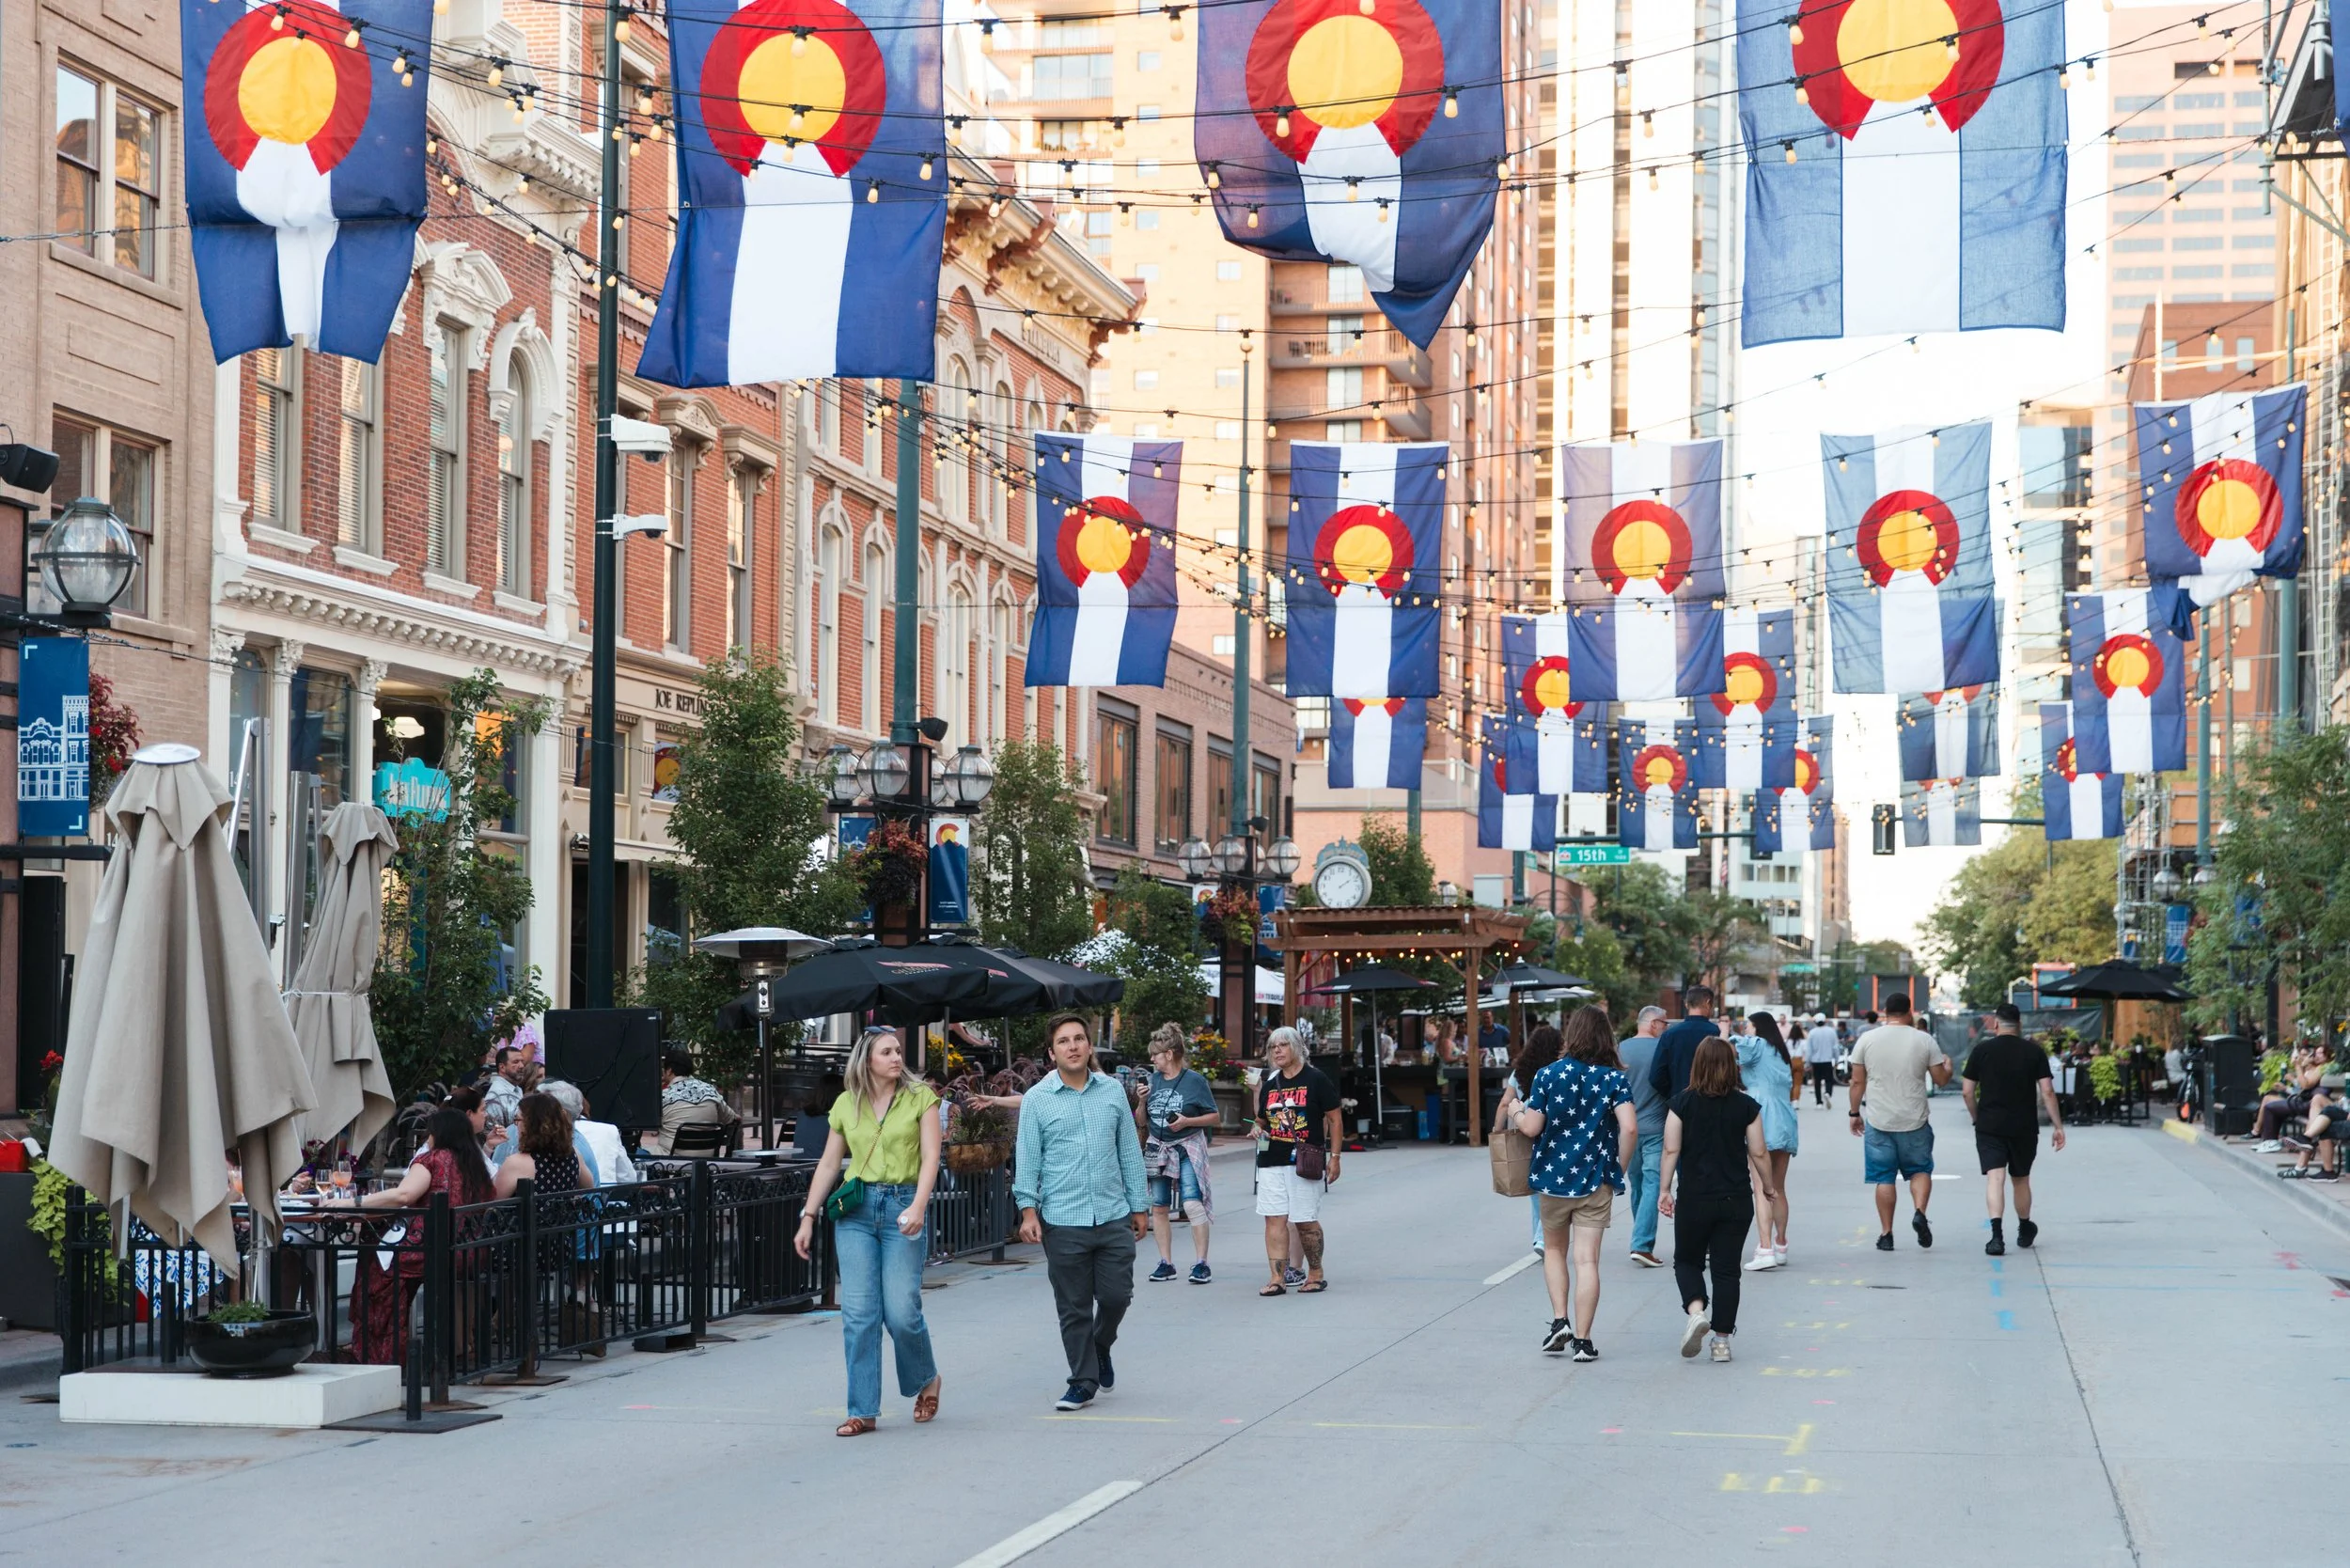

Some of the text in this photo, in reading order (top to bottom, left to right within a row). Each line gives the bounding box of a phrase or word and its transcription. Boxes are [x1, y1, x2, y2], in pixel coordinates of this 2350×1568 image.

[655, 688, 672, 709] JOE
[1577, 849, 1606, 861] 15th
[1266, 1089, 1308, 1109] WLLIE
